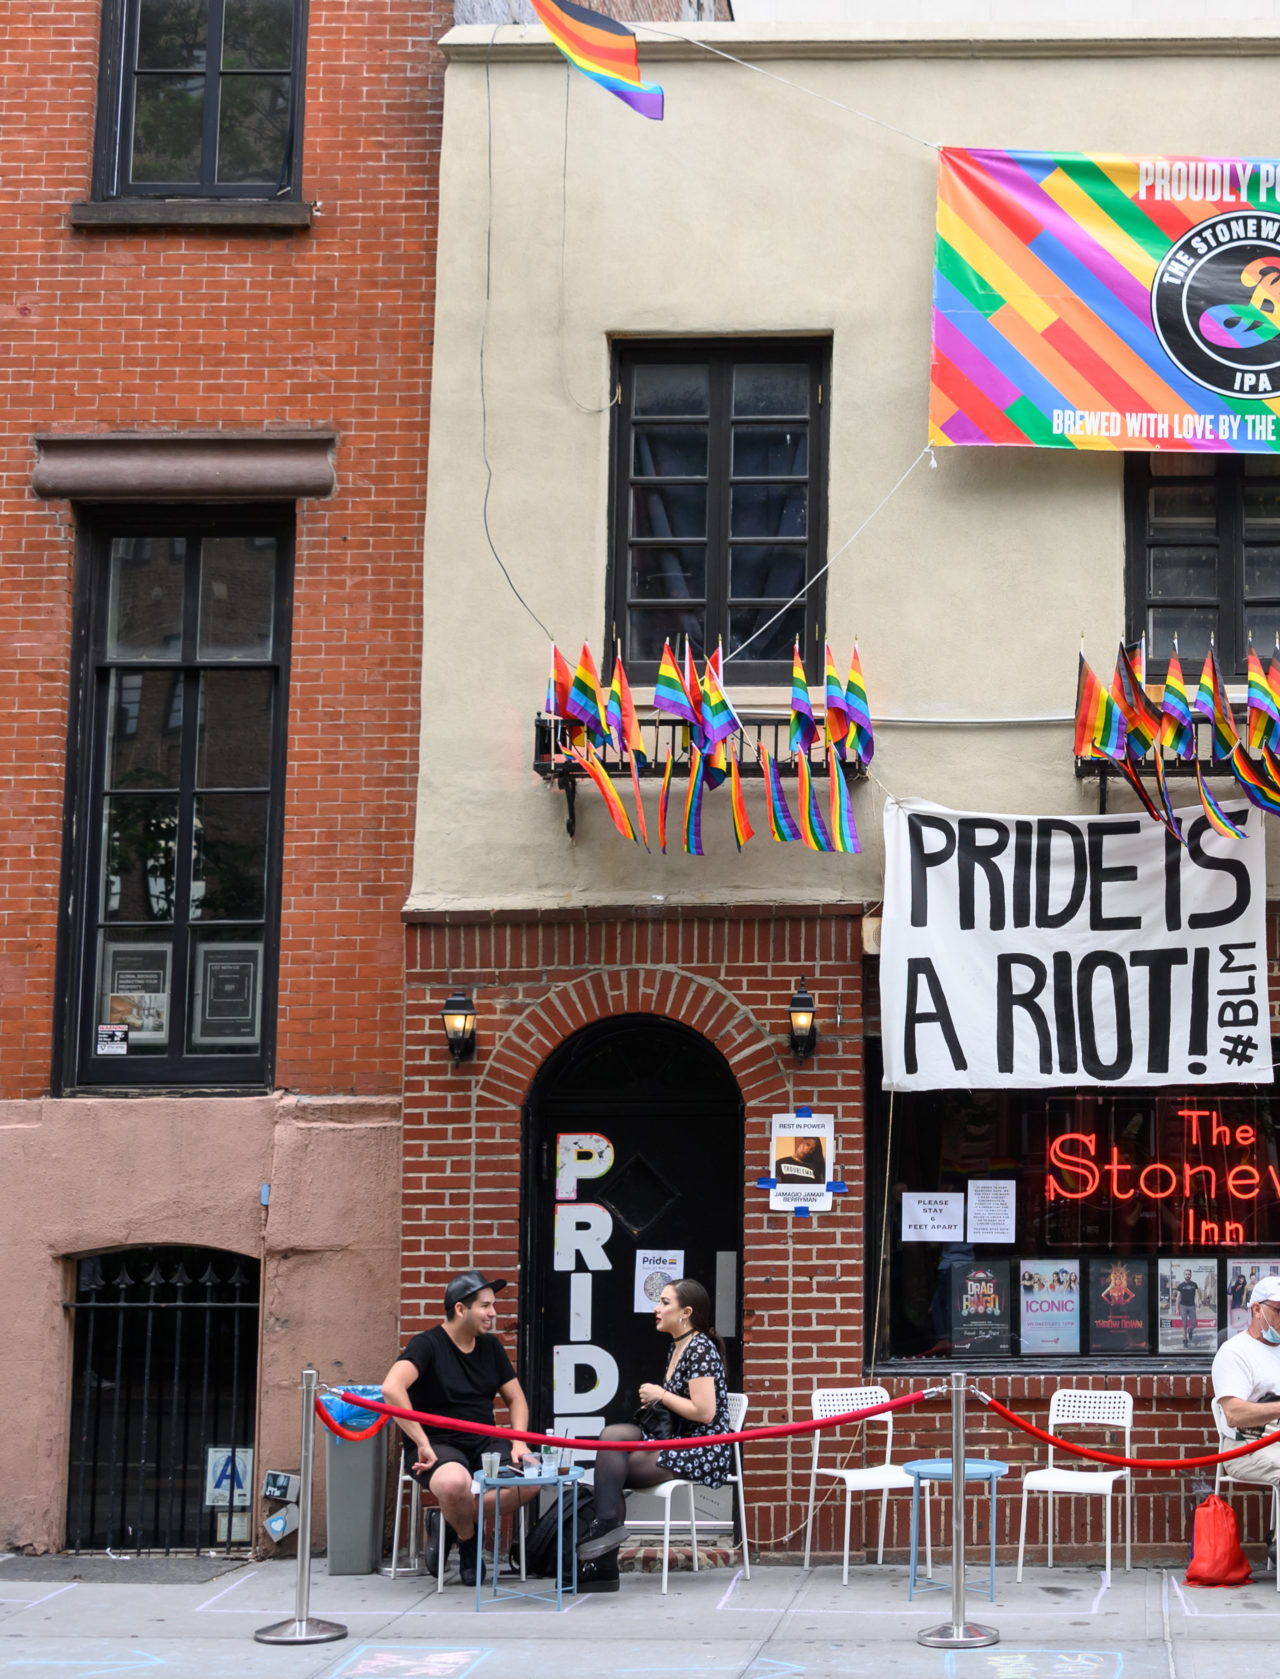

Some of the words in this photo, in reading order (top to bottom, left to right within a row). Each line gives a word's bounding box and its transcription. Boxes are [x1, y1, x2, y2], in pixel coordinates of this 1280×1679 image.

[1139, 161, 1257, 204] PROUDLY
[1162, 250, 1195, 286] THE
[1233, 372, 1272, 392] IPA
[1052, 409, 1121, 437] BREWED
[1125, 411, 1169, 439] WITH
[1173, 413, 1216, 440] LOVE
[1218, 415, 1240, 441] BY
[1243, 415, 1277, 442] THE
[907, 813, 1142, 931] PRIDE
[1164, 809, 1251, 931] IS
[904, 956, 968, 1075] A
[997, 947, 1210, 1081] RIOT!
[1217, 941, 1260, 1067] #BLM
[1177, 1110, 1256, 1146] The
[1188, 1208, 1245, 1244] Inn
[642, 1256, 668, 1265] Pride
[962, 1294, 999, 1312] BINGO
[967, 1281, 994, 1295] DRAG
[1026, 1299, 1075, 1313] ICONIC
[554, 1132, 619, 1485] PRIDE
[213, 1455, 244, 1489] A
